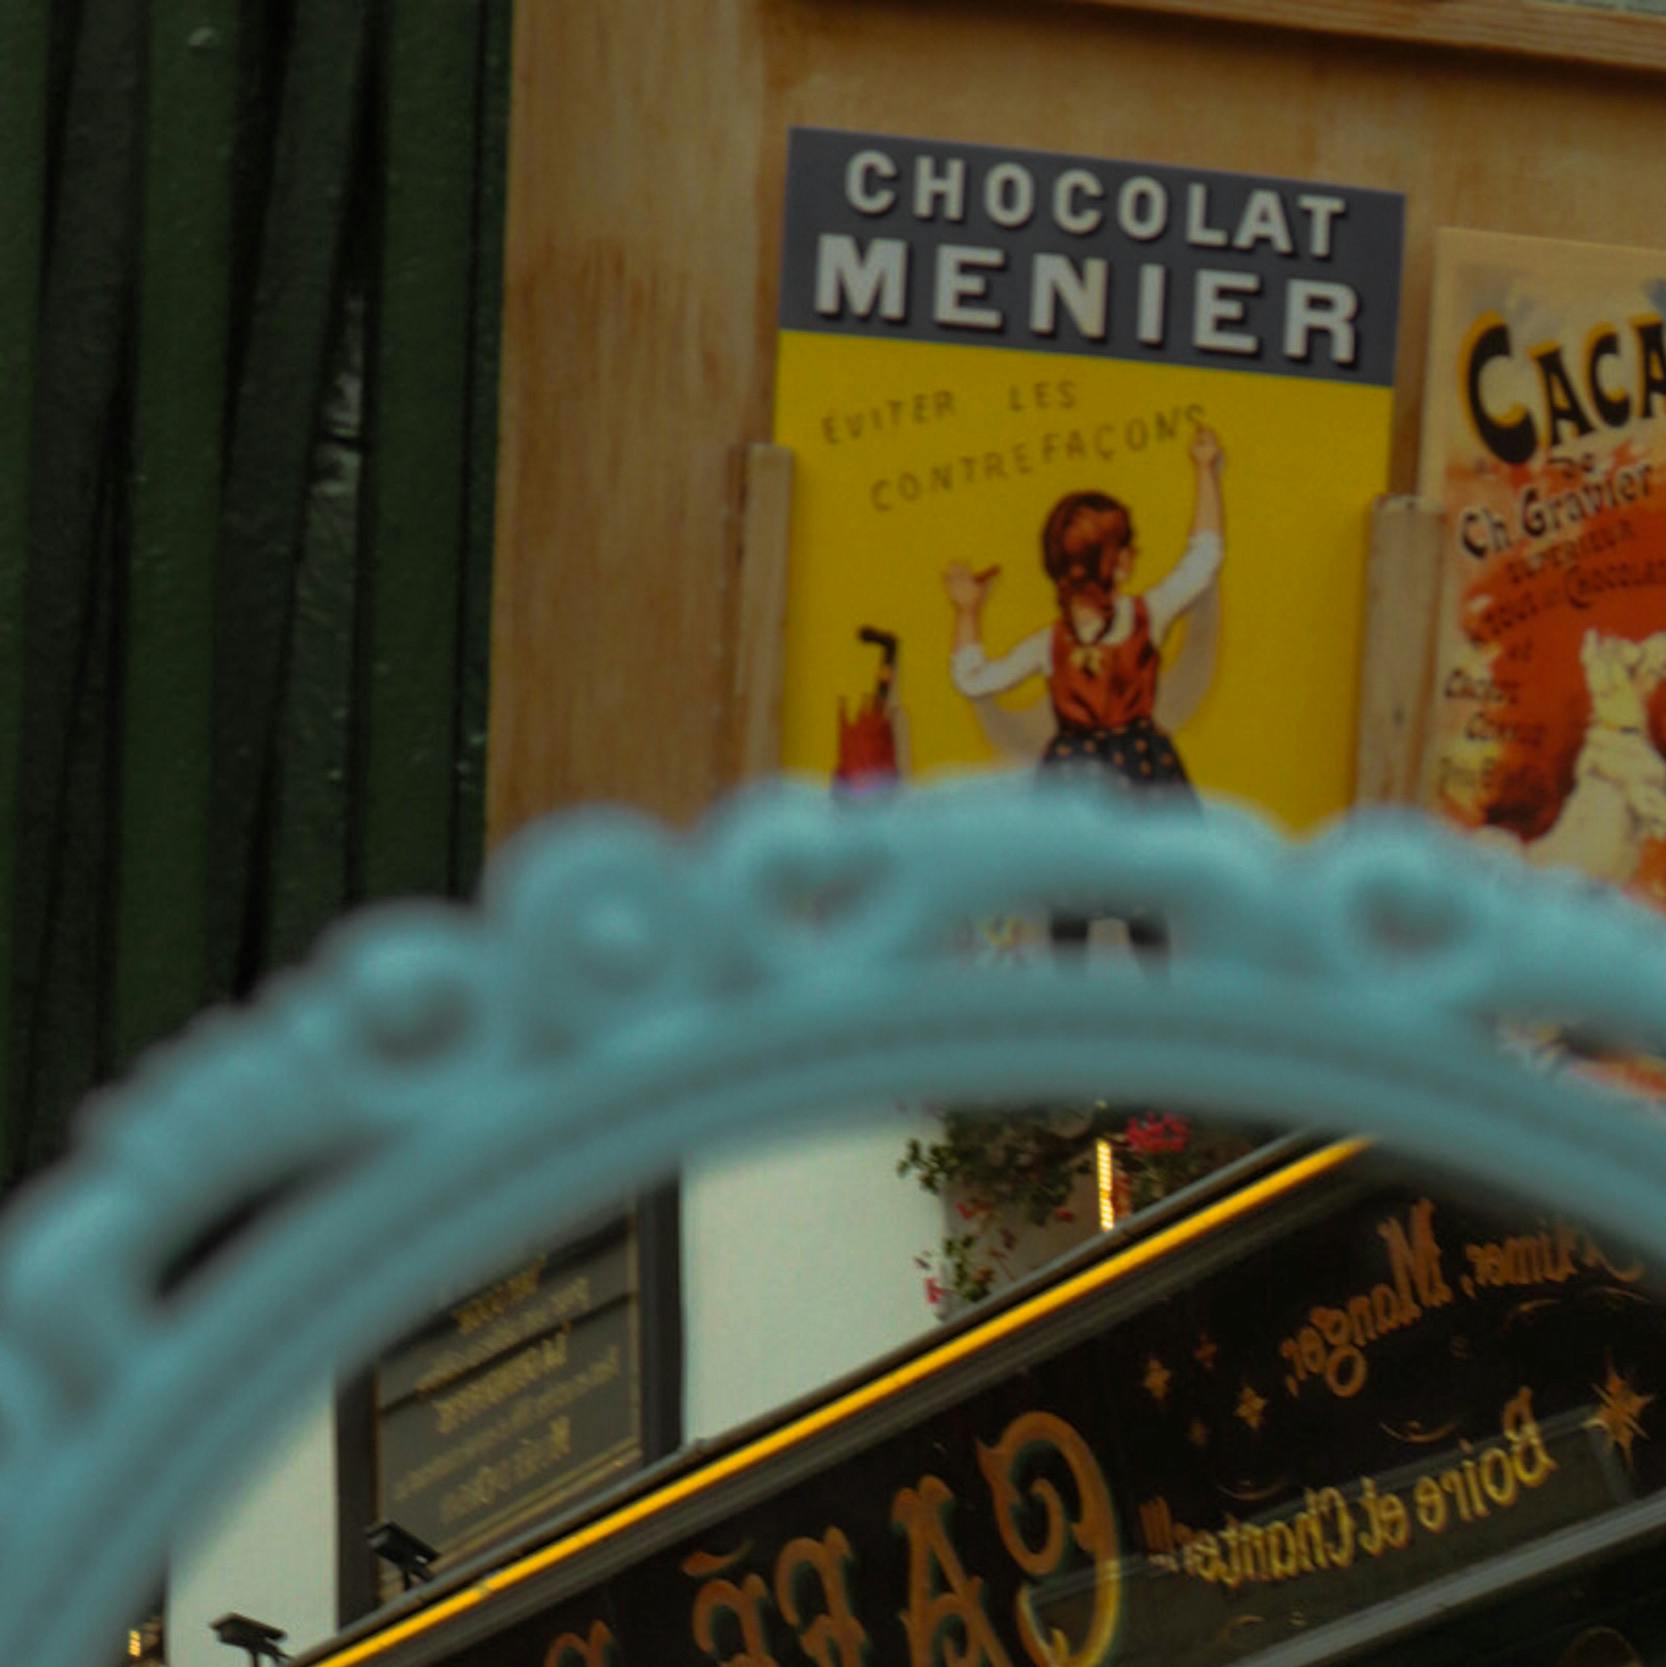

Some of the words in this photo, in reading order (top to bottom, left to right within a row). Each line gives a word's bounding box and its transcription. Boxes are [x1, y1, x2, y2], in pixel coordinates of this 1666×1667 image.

[844, 148, 1348, 260] CHOCOLAT
[813, 231, 1362, 368] MENIER
[1006, 379, 1079, 413] LES
